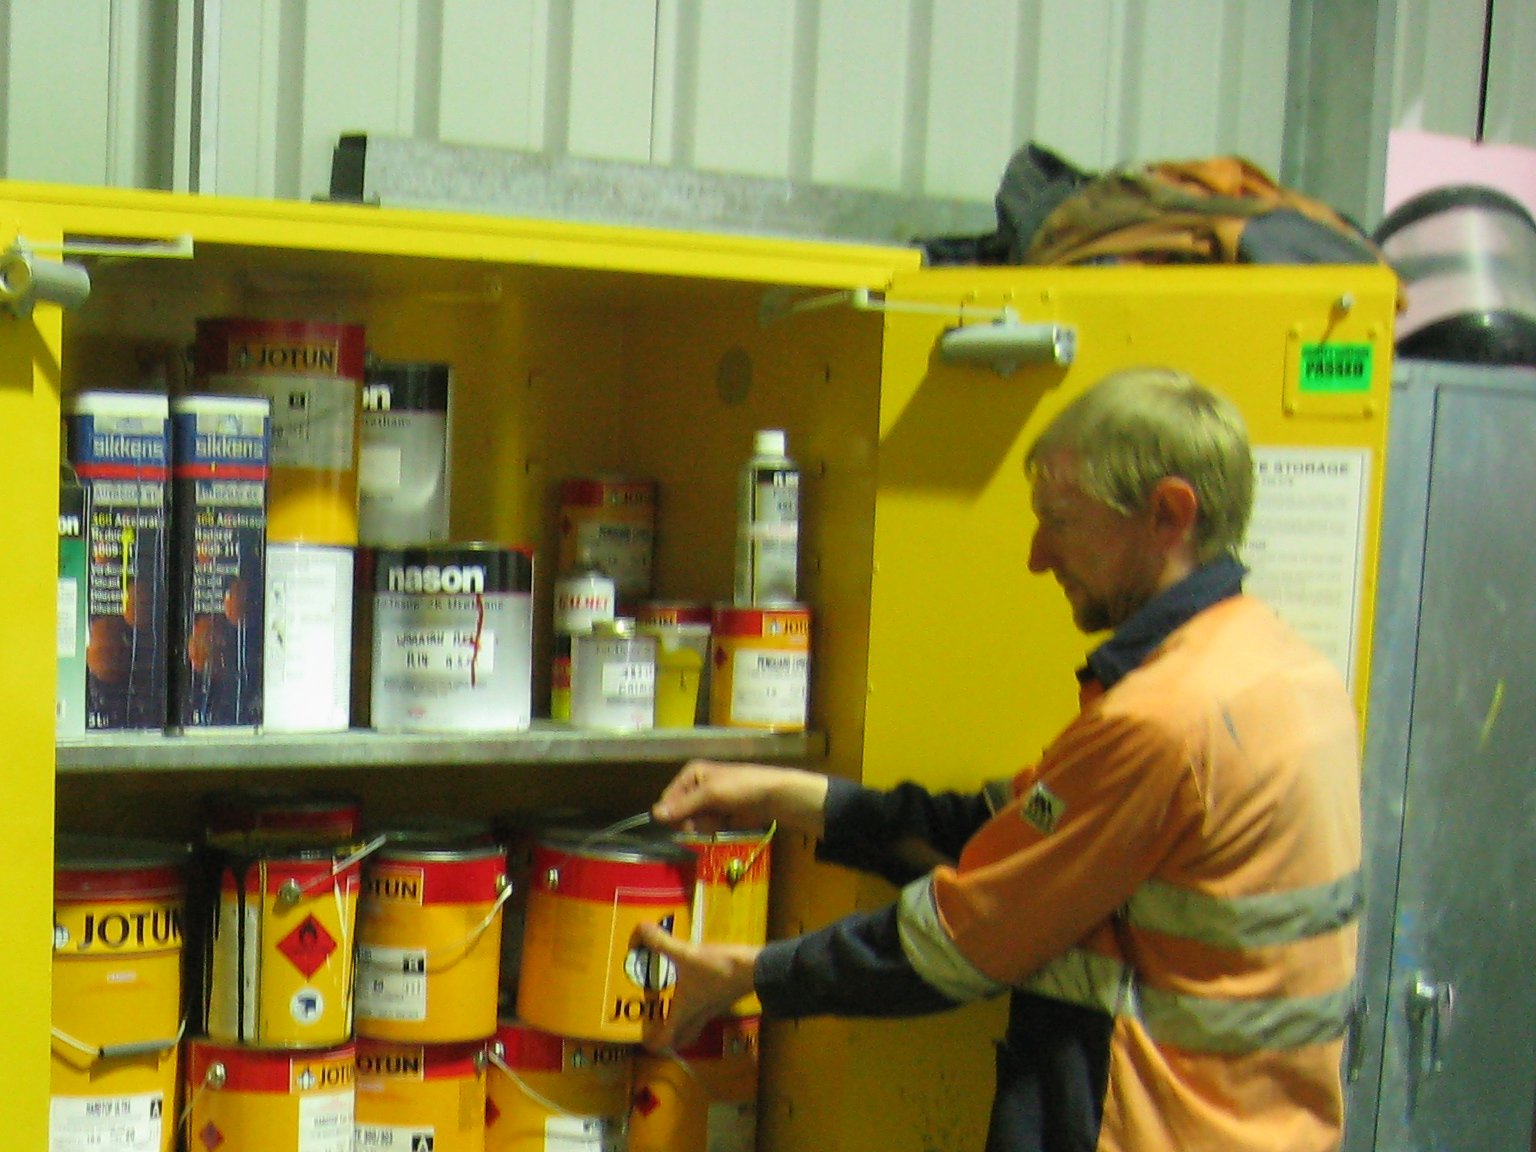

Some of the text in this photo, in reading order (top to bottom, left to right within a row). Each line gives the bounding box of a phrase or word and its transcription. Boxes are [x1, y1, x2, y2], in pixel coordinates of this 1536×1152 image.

[259, 348, 334, 370] JOTUN
[93, 433, 164, 459] sikkens
[388, 565, 484, 595] nason
